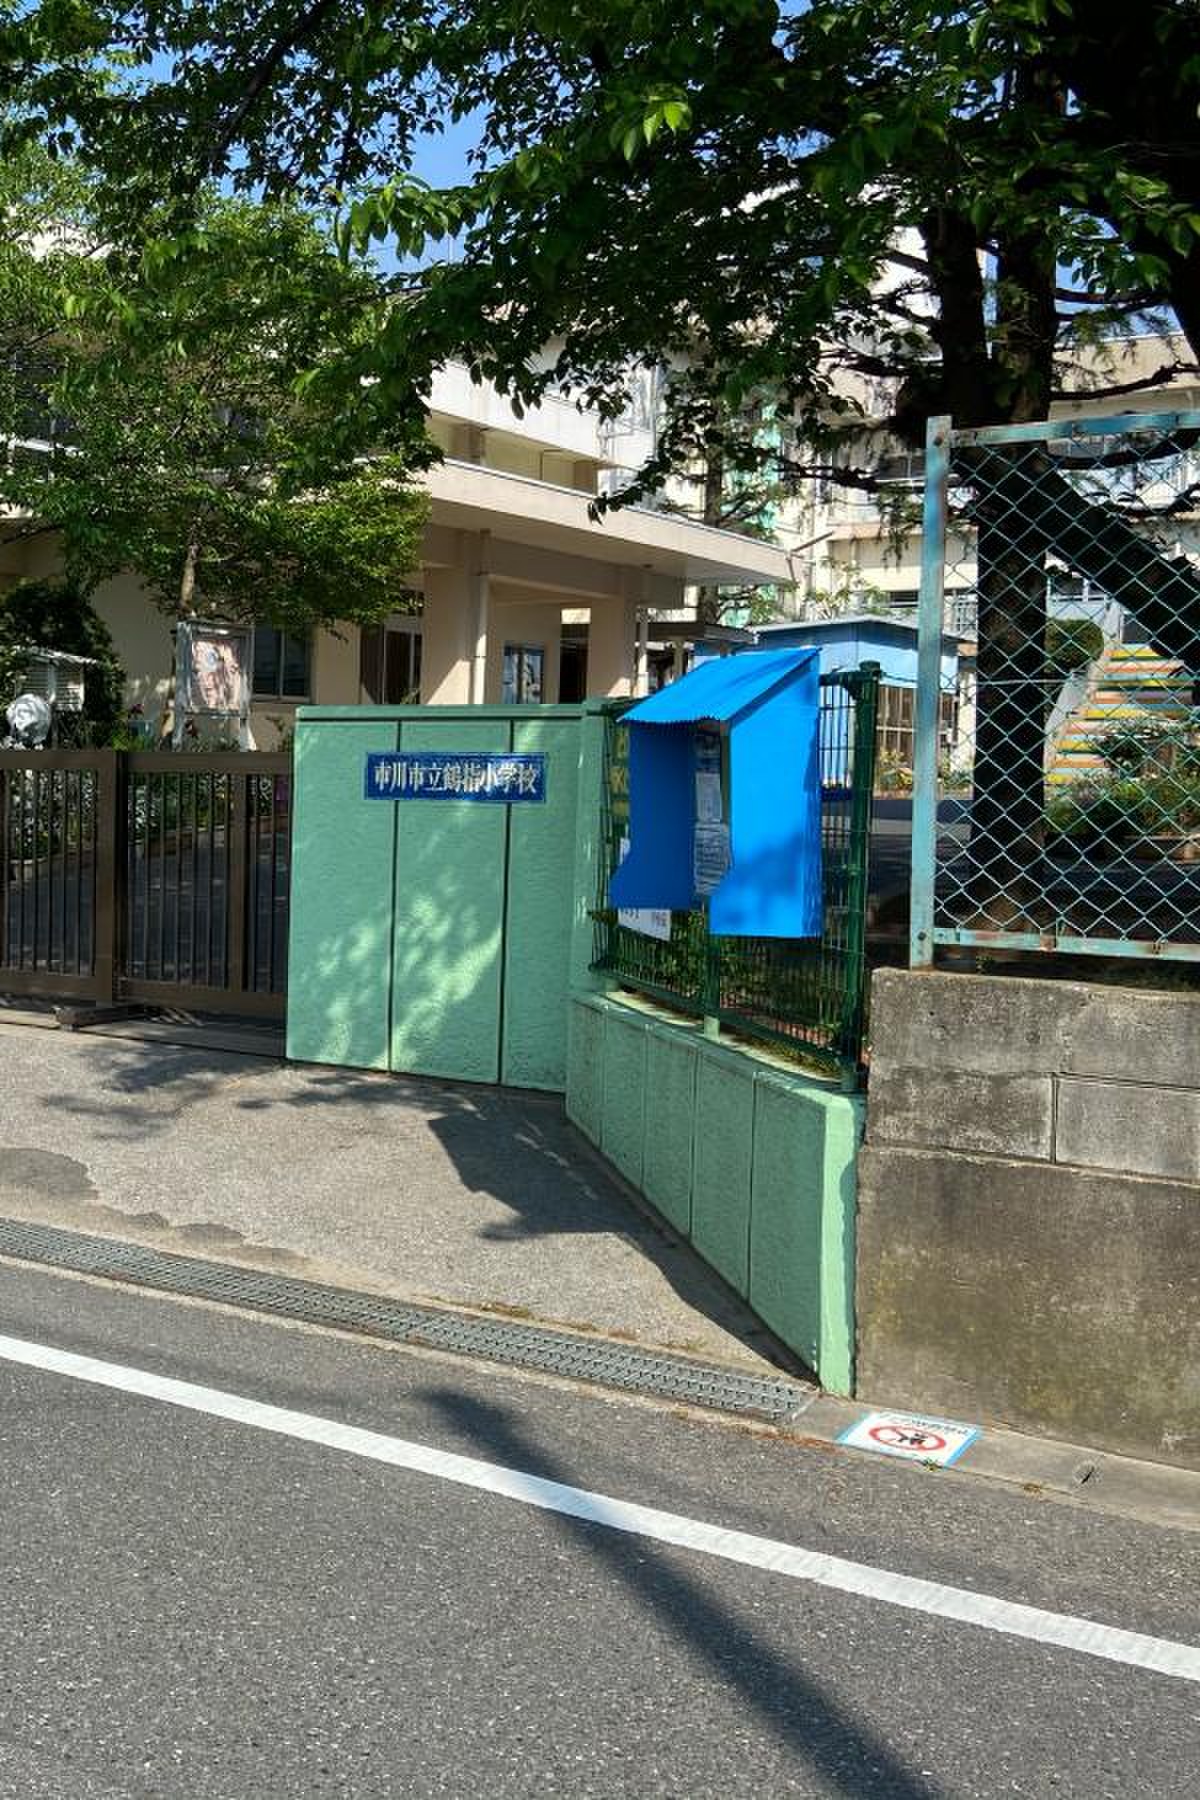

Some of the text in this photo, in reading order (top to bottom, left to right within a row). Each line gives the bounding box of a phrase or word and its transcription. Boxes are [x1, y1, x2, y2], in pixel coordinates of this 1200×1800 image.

[374, 760, 537, 794] 市川市立鶴指小学校
